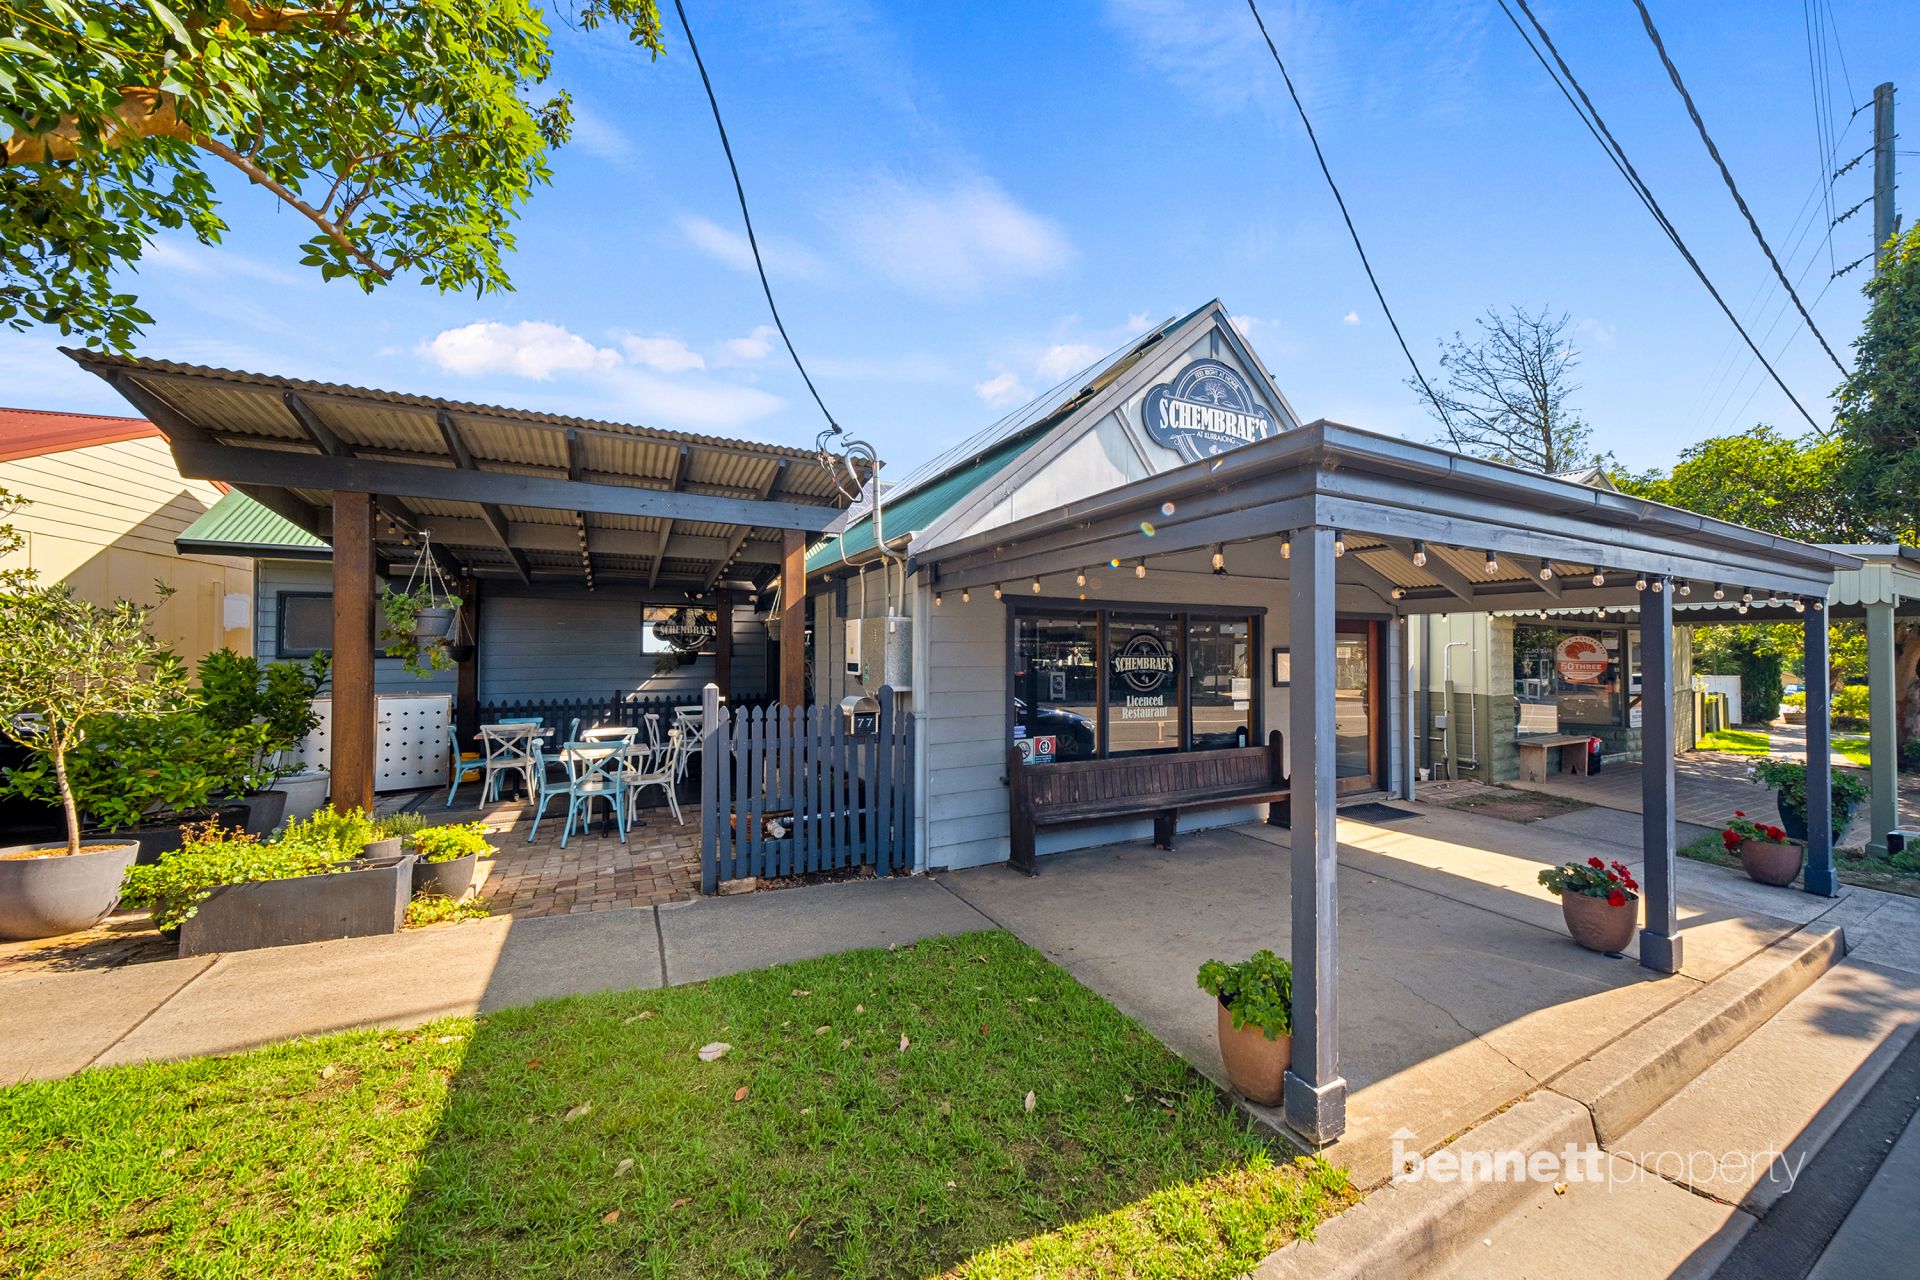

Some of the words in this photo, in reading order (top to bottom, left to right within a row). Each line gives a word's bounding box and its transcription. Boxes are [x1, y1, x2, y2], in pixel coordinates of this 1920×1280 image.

[1159, 398, 1268, 443] SCHEMBRAE'S
[660, 625, 717, 636] SCHEMBRAE'S
[1115, 657, 1174, 673] SCHEMBRAE'S
[1126, 695, 1164, 707] Licenced
[1121, 706, 1168, 719] Restaurant
[857, 718, 873, 728] 77
